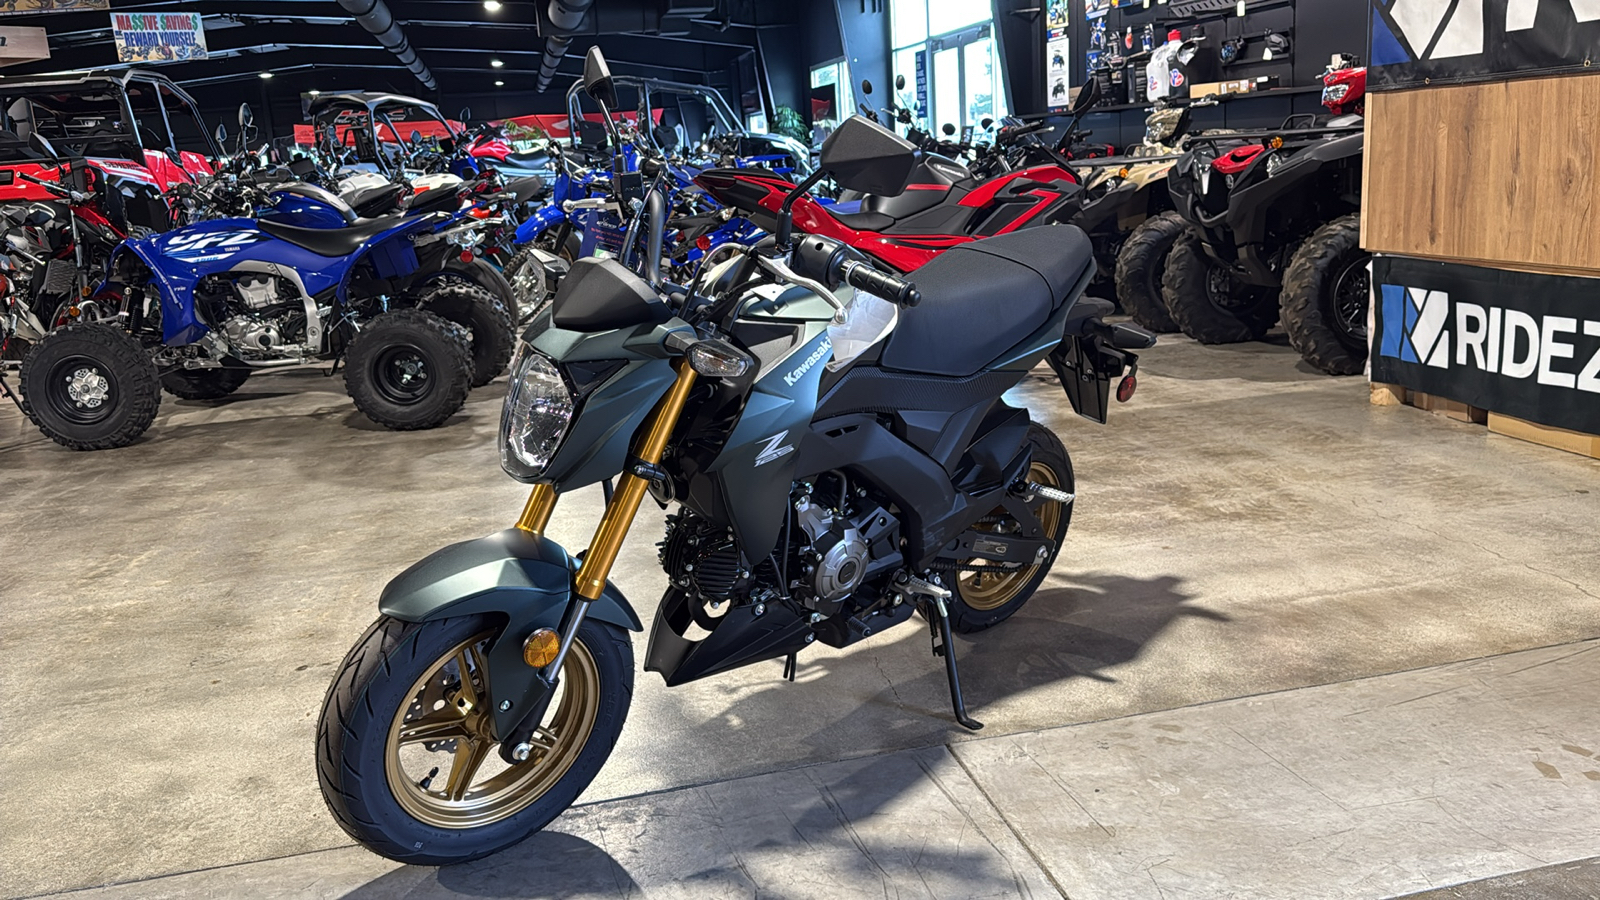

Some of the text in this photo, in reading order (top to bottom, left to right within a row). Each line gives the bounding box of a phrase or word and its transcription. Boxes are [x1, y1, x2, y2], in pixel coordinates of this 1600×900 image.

[115, 14, 198, 31] MA$$IVE $AVING$
[124, 31, 159, 47] REWARD
[159, 31, 196, 47] YOURSELF
[783, 335, 832, 387] Kawasaki
